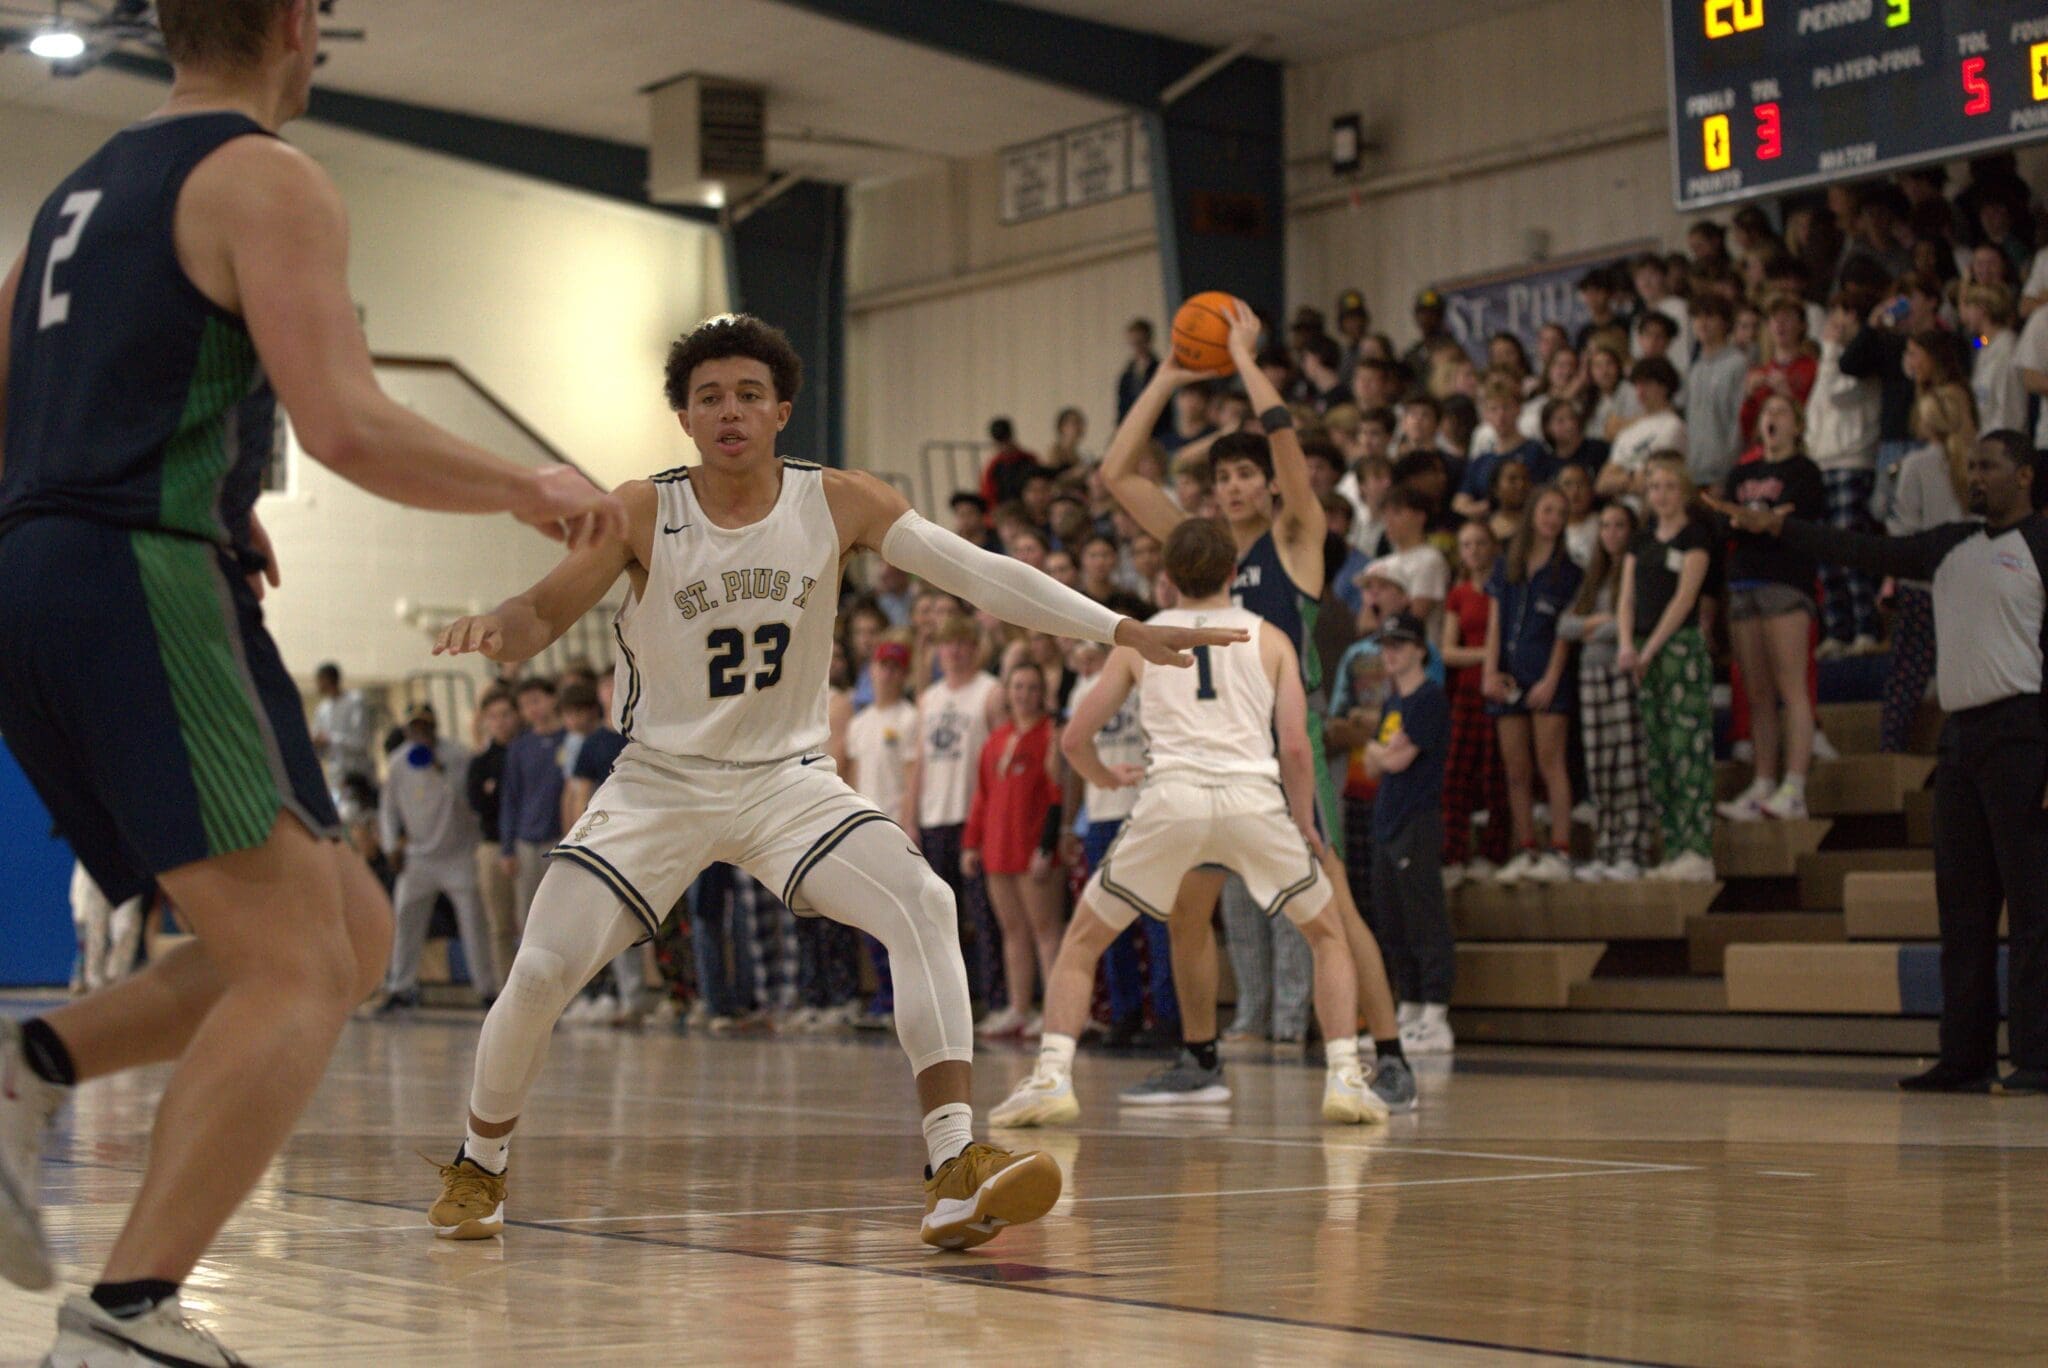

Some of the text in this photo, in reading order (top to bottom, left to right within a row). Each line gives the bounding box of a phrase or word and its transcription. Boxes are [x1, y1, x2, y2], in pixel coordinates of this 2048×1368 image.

[1798, 0, 1872, 35] PERIOD
[1961, 56, 1991, 116] 5
[1703, 114, 1731, 172] 0
[1753, 102, 1782, 160] 3
[37, 188, 103, 332] 2
[674, 568, 817, 620] ST. PIUS X
[706, 621, 791, 699] 23
[1193, 645, 1217, 699] 1
